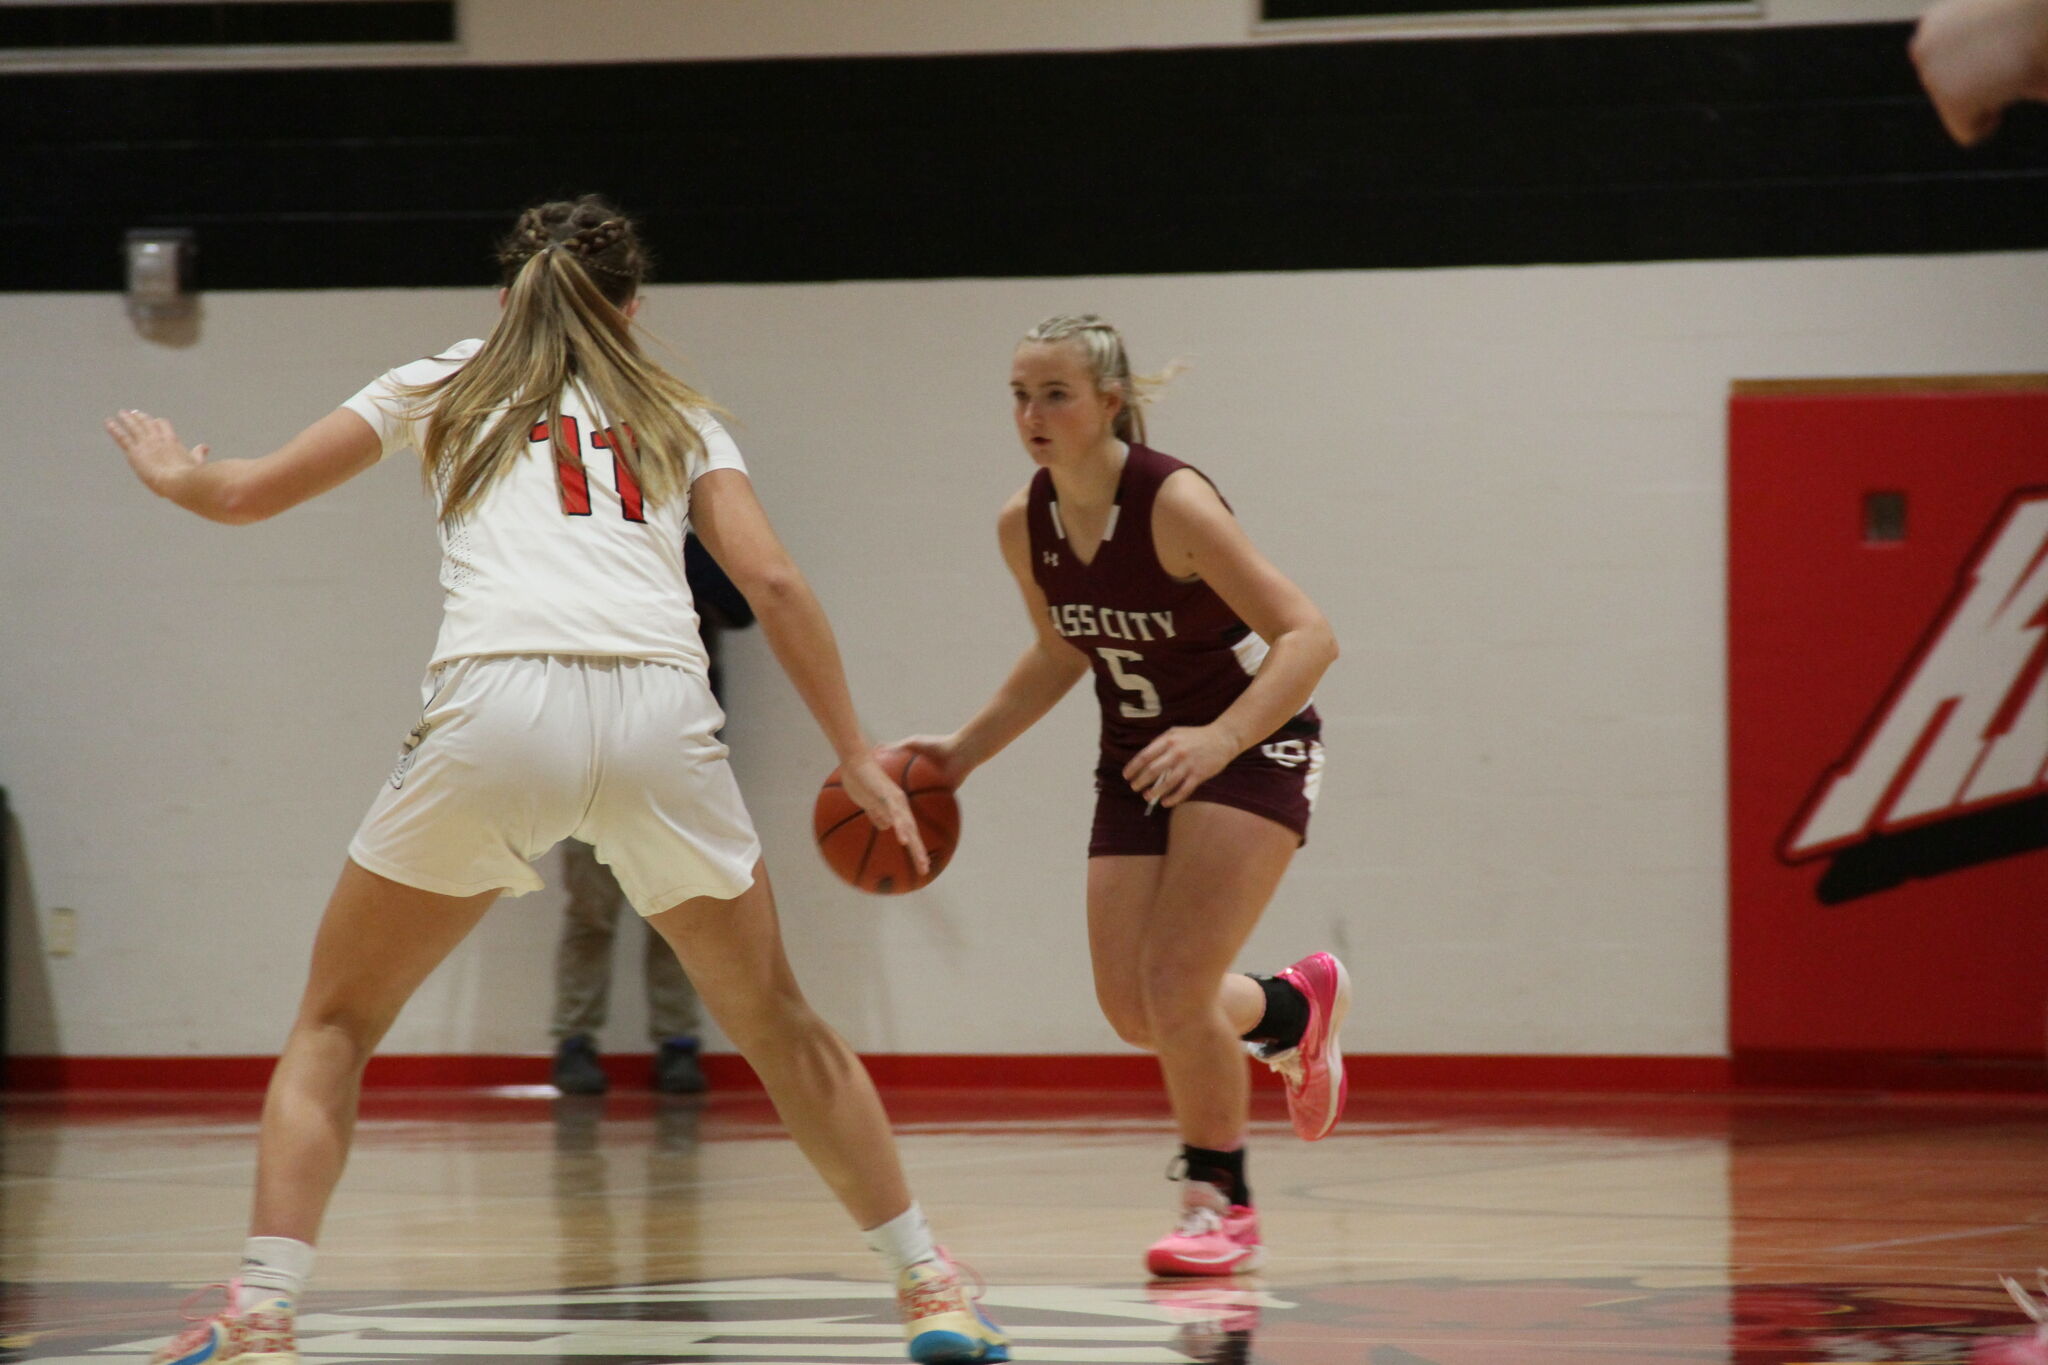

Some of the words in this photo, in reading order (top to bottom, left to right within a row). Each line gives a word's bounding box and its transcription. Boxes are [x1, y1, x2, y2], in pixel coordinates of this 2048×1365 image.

[529, 415, 648, 524] 11
[1100, 607, 1176, 641] CITY
[1096, 647, 1162, 718] 5
